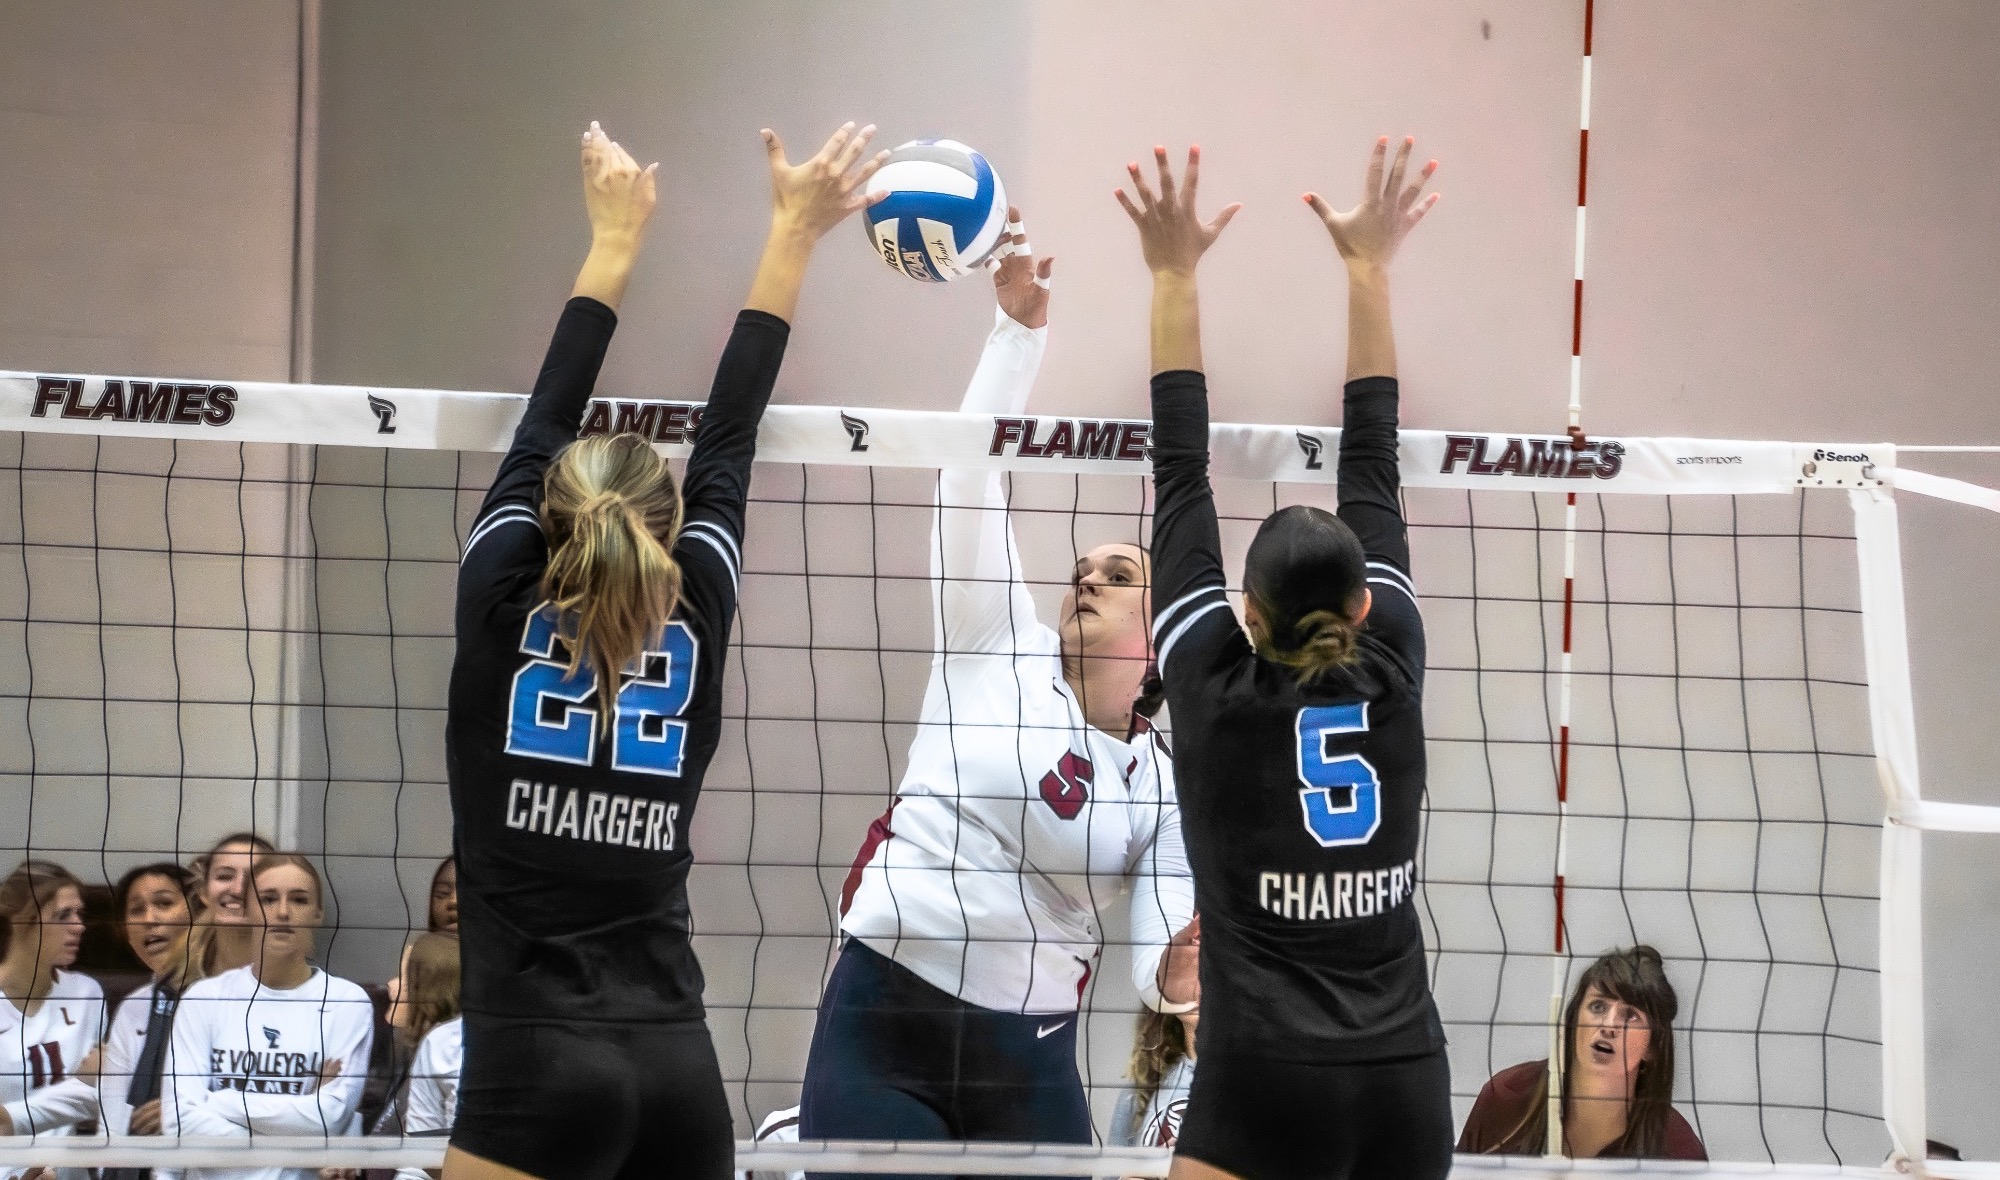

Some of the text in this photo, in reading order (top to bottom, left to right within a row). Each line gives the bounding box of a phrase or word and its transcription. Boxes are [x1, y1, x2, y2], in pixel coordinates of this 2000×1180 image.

[30, 376, 238, 427] FLAMES
[989, 417, 1153, 461] FLAME
[1440, 435, 1625, 479] FLAMES
[1826, 451, 1869, 463] Senoh
[504, 599, 699, 778] 22
[1295, 702, 1381, 848] 5
[506, 778, 680, 851] CHARGERS
[60, 1007, 76, 1026] L
